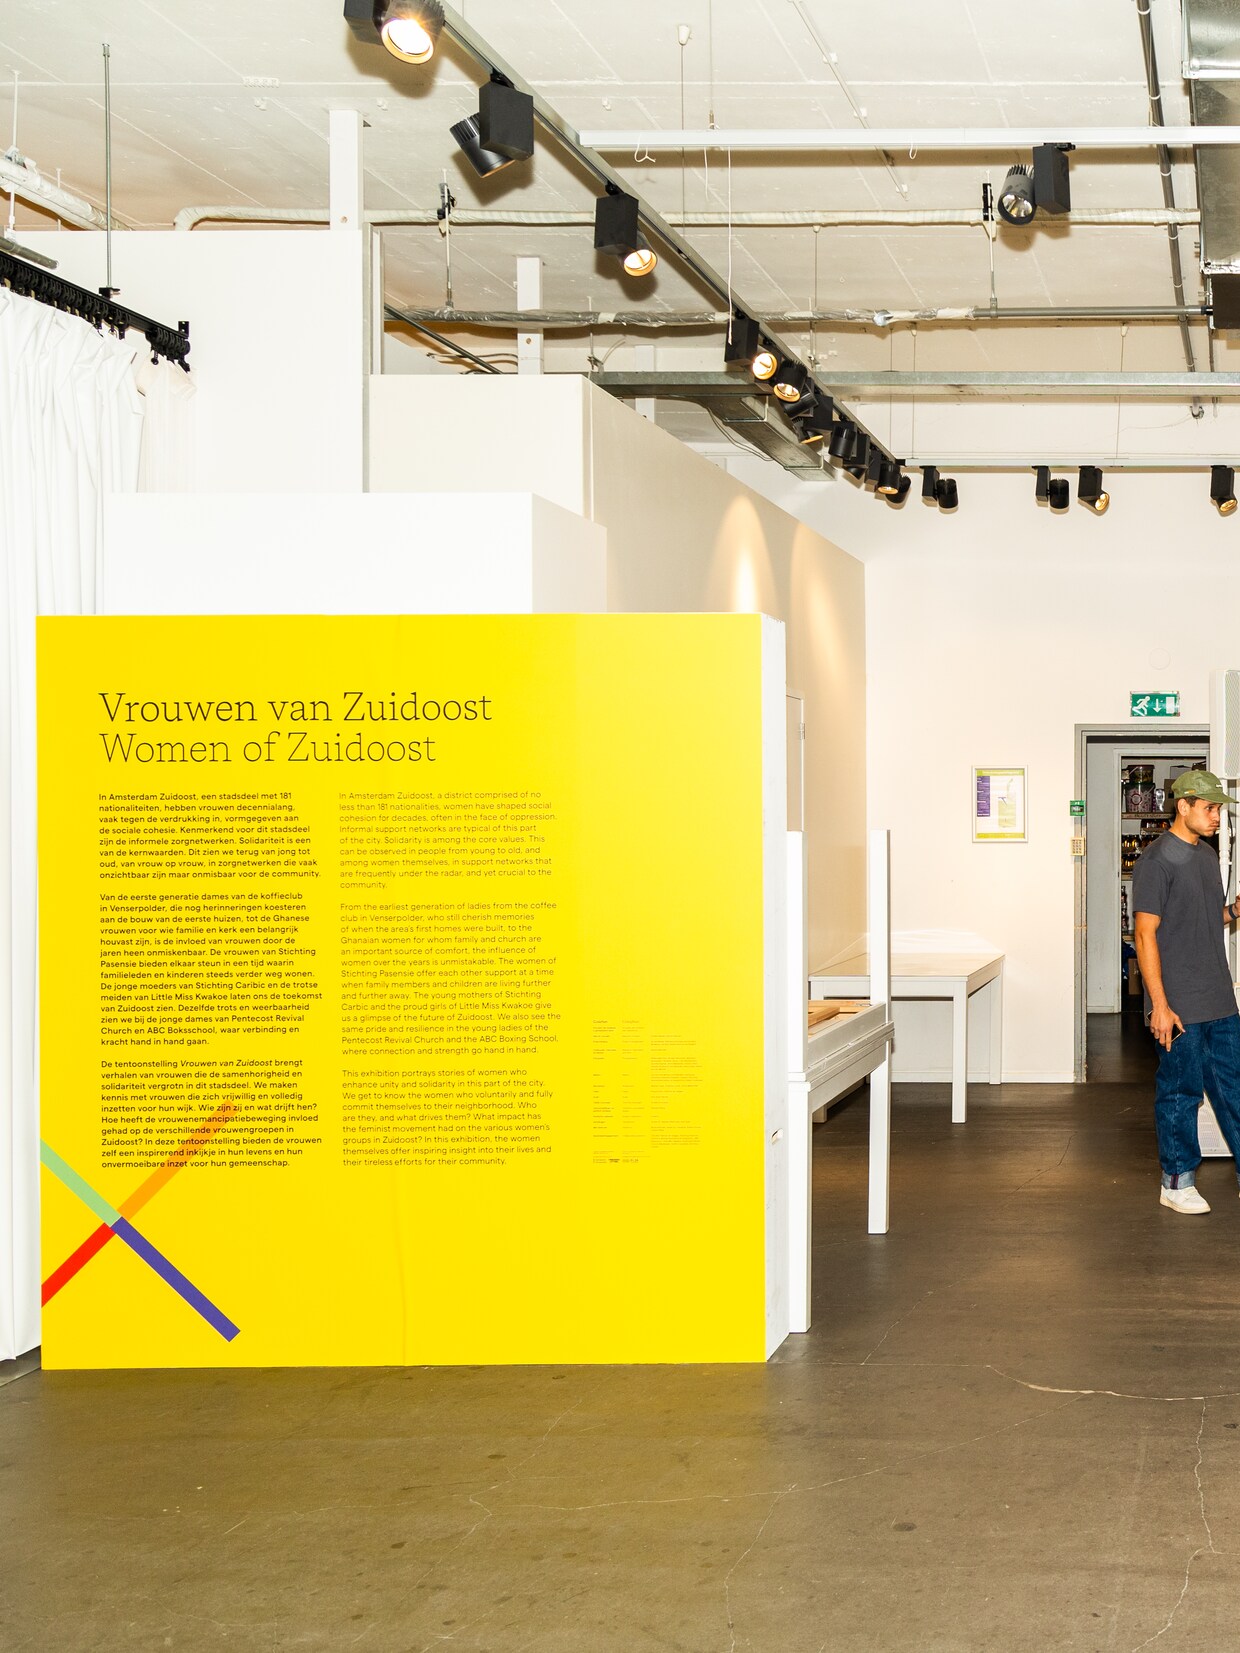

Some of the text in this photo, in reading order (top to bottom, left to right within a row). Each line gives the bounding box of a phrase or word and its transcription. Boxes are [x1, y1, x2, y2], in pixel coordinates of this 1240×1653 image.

[99, 691, 492, 722] Vrouwen van Zuidoost
[99, 731, 436, 763] Women of Zuidoost
[98, 793, 107, 801] In
[108, 793, 158, 801] Amsterdam
[159, 792, 199, 802] Zuidoost,
[218, 792, 259, 800] stadsdeel
[279, 791, 292, 799] 181
[348, 791, 395, 799] Amsterdam
[443, 790, 473, 798] district
[474, 790, 518, 800] comprised
[519, 790, 529, 798] of
[236, 803, 295, 813] decennialang,
[338, 803, 355, 811] less
[377, 802, 388, 810] 181
[475, 801, 495, 809] have
[496, 801, 527, 811] shaped
[528, 801, 552, 809] social
[120, 815, 145, 825] tegen
[146, 815, 158, 823] de
[159, 815, 210, 825] verdrukking
[212, 814, 222, 824] in,
[224, 816, 282, 824] vormgegeven
[339, 814, 377, 822] cohesion
[378, 813, 390, 821] for
[430, 813, 453, 821] often
[463, 812, 478, 820] the
[479, 812, 498, 820] face
[499, 812, 508, 820] of
[111, 826, 141, 834] sociale
[142, 826, 178, 834] cohesie.
[256, 825, 268, 833] dit
[270, 825, 310, 833] stadsdeel
[339, 825, 373, 833] Informal
[375, 825, 407, 834] support
[408, 824, 447, 832] networks
[463, 824, 491, 834] typical
[502, 823, 518, 831] this
[519, 823, 537, 833] part
[99, 838, 114, 847] zijn
[115, 837, 127, 845] de
[128, 837, 169, 845] informele
[170, 837, 237, 846] zorgnetwerken.
[239, 836, 285, 844] Solidariteit
[286, 836, 293, 844] is
[128, 848, 186, 856] kernwaarden.
[188, 848, 201, 856] Dit
[202, 848, 220, 856] zien
[235, 848, 259, 857] terug
[277, 847, 296, 857] jong
[298, 847, 311, 855] tot
[99, 860, 118, 870] oud,
[164, 861, 177, 869] op
[177, 861, 206, 869] vrouw,
[208, 859, 216, 867] in
[218, 859, 282, 868] zorgnetwerken
[283, 858, 297, 866] die
[298, 858, 318, 866] vaak
[99, 871, 150, 879] onzichtbaar
[151, 871, 167, 880] zijn
[191, 870, 236, 878] onmisbaar
[271, 869, 321, 879] community.
[101, 1060, 113, 1068] De
[114, 1060, 178, 1070] tentoonstelling
[180, 1059, 217, 1067] Vrouwen
[274, 1058, 303, 1068] brengt
[100, 1071, 138, 1079] verhalen
[194, 1070, 208, 1078] die
[209, 1070, 220, 1078] de
[222, 1070, 290, 1080] samenhorigheid
[341, 1069, 359, 1077] This
[360, 1069, 400, 1077] exhibition
[401, 1069, 436, 1078] portrays
[437, 1068, 465, 1076] stories
[466, 1068, 476, 1076] of
[101, 1082, 146, 1090] solidariteit
[147, 1082, 184, 1092] vergrotn
[195, 1081, 207, 1089] dit
[208, 1081, 251, 1089] stadsdeel.
[253, 1081, 267, 1089] We
[130, 1093, 147, 1101] met
[187, 1093, 201, 1101] die
[221, 1092, 256, 1102] vrijwillig
[270, 1092, 303, 1102] volledig
[101, 1104, 136, 1112] inzetten
[158, 1104, 175, 1112] hun
[176, 1104, 196, 1114] wijk.
[216, 1104, 231, 1113] zijn
[232, 1103, 242, 1113] zij
[256, 1103, 272, 1111] wat
[273, 1103, 295, 1113] drijft
